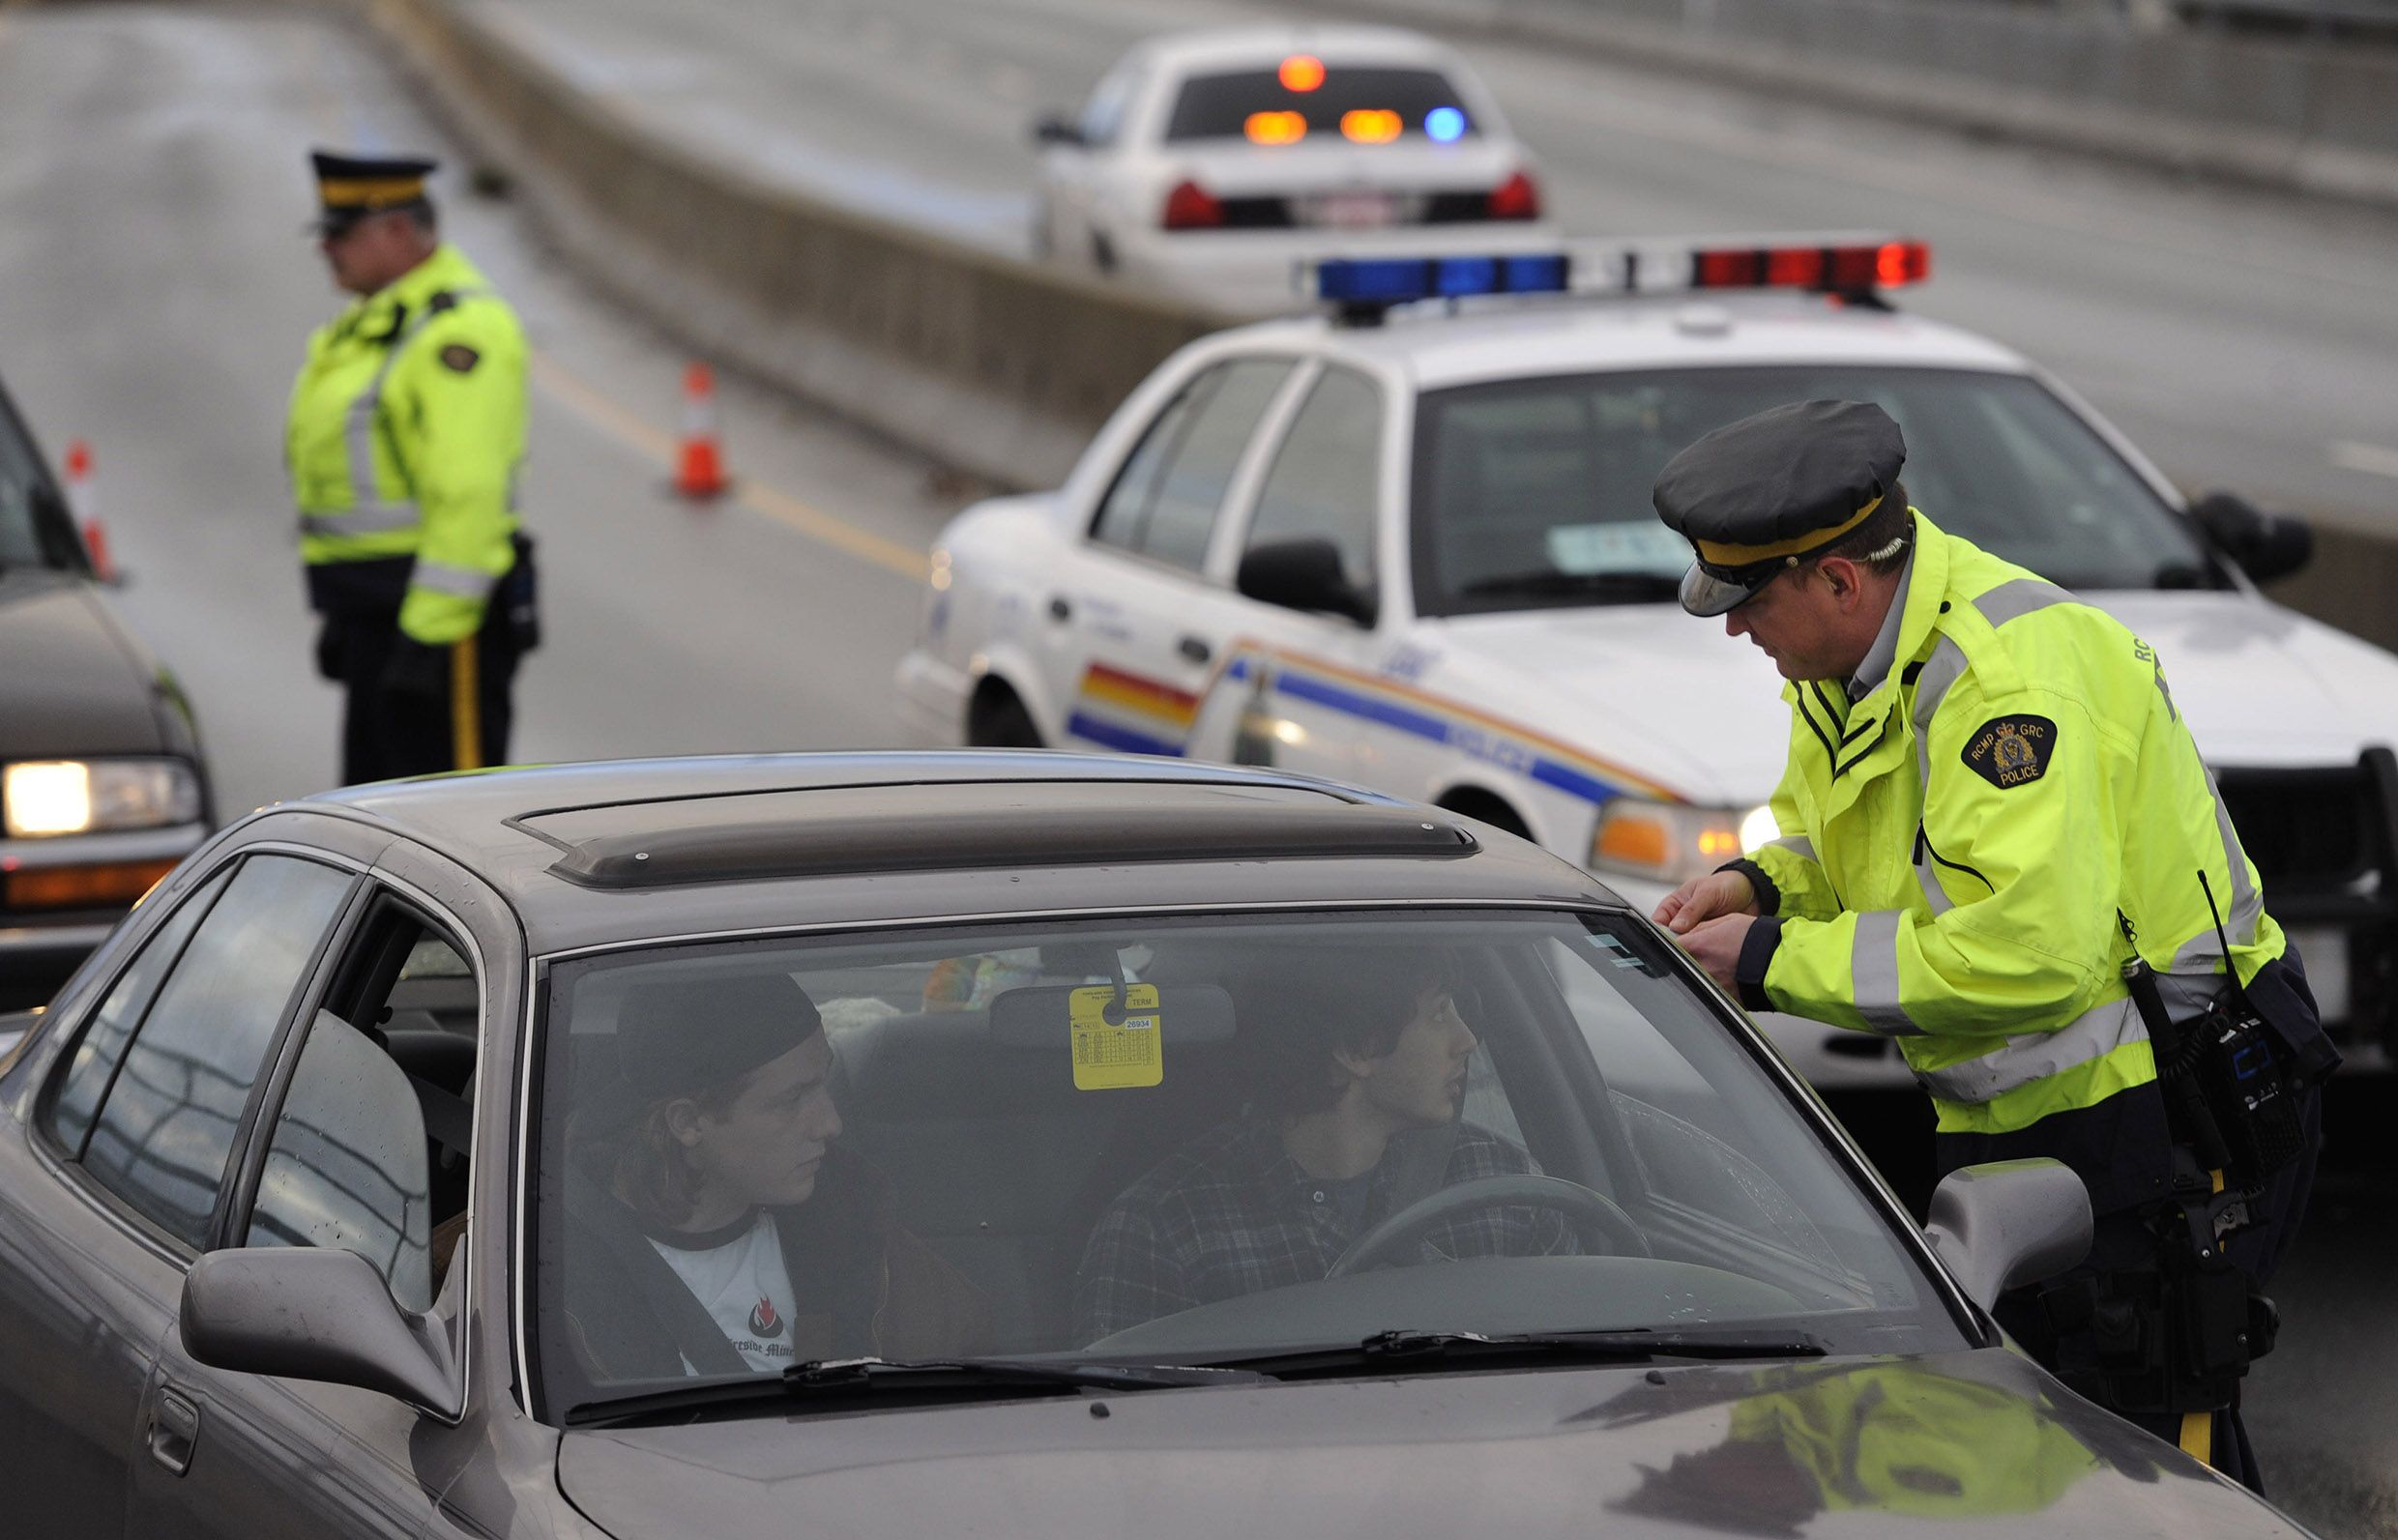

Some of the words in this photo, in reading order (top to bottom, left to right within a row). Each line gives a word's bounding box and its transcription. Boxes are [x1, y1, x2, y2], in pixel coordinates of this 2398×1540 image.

[1971, 733, 1994, 761] RCMP
[2020, 723, 2044, 739] GRC
[2000, 764, 2039, 786] POLICE
[1132, 998, 1153, 1006] TERM
